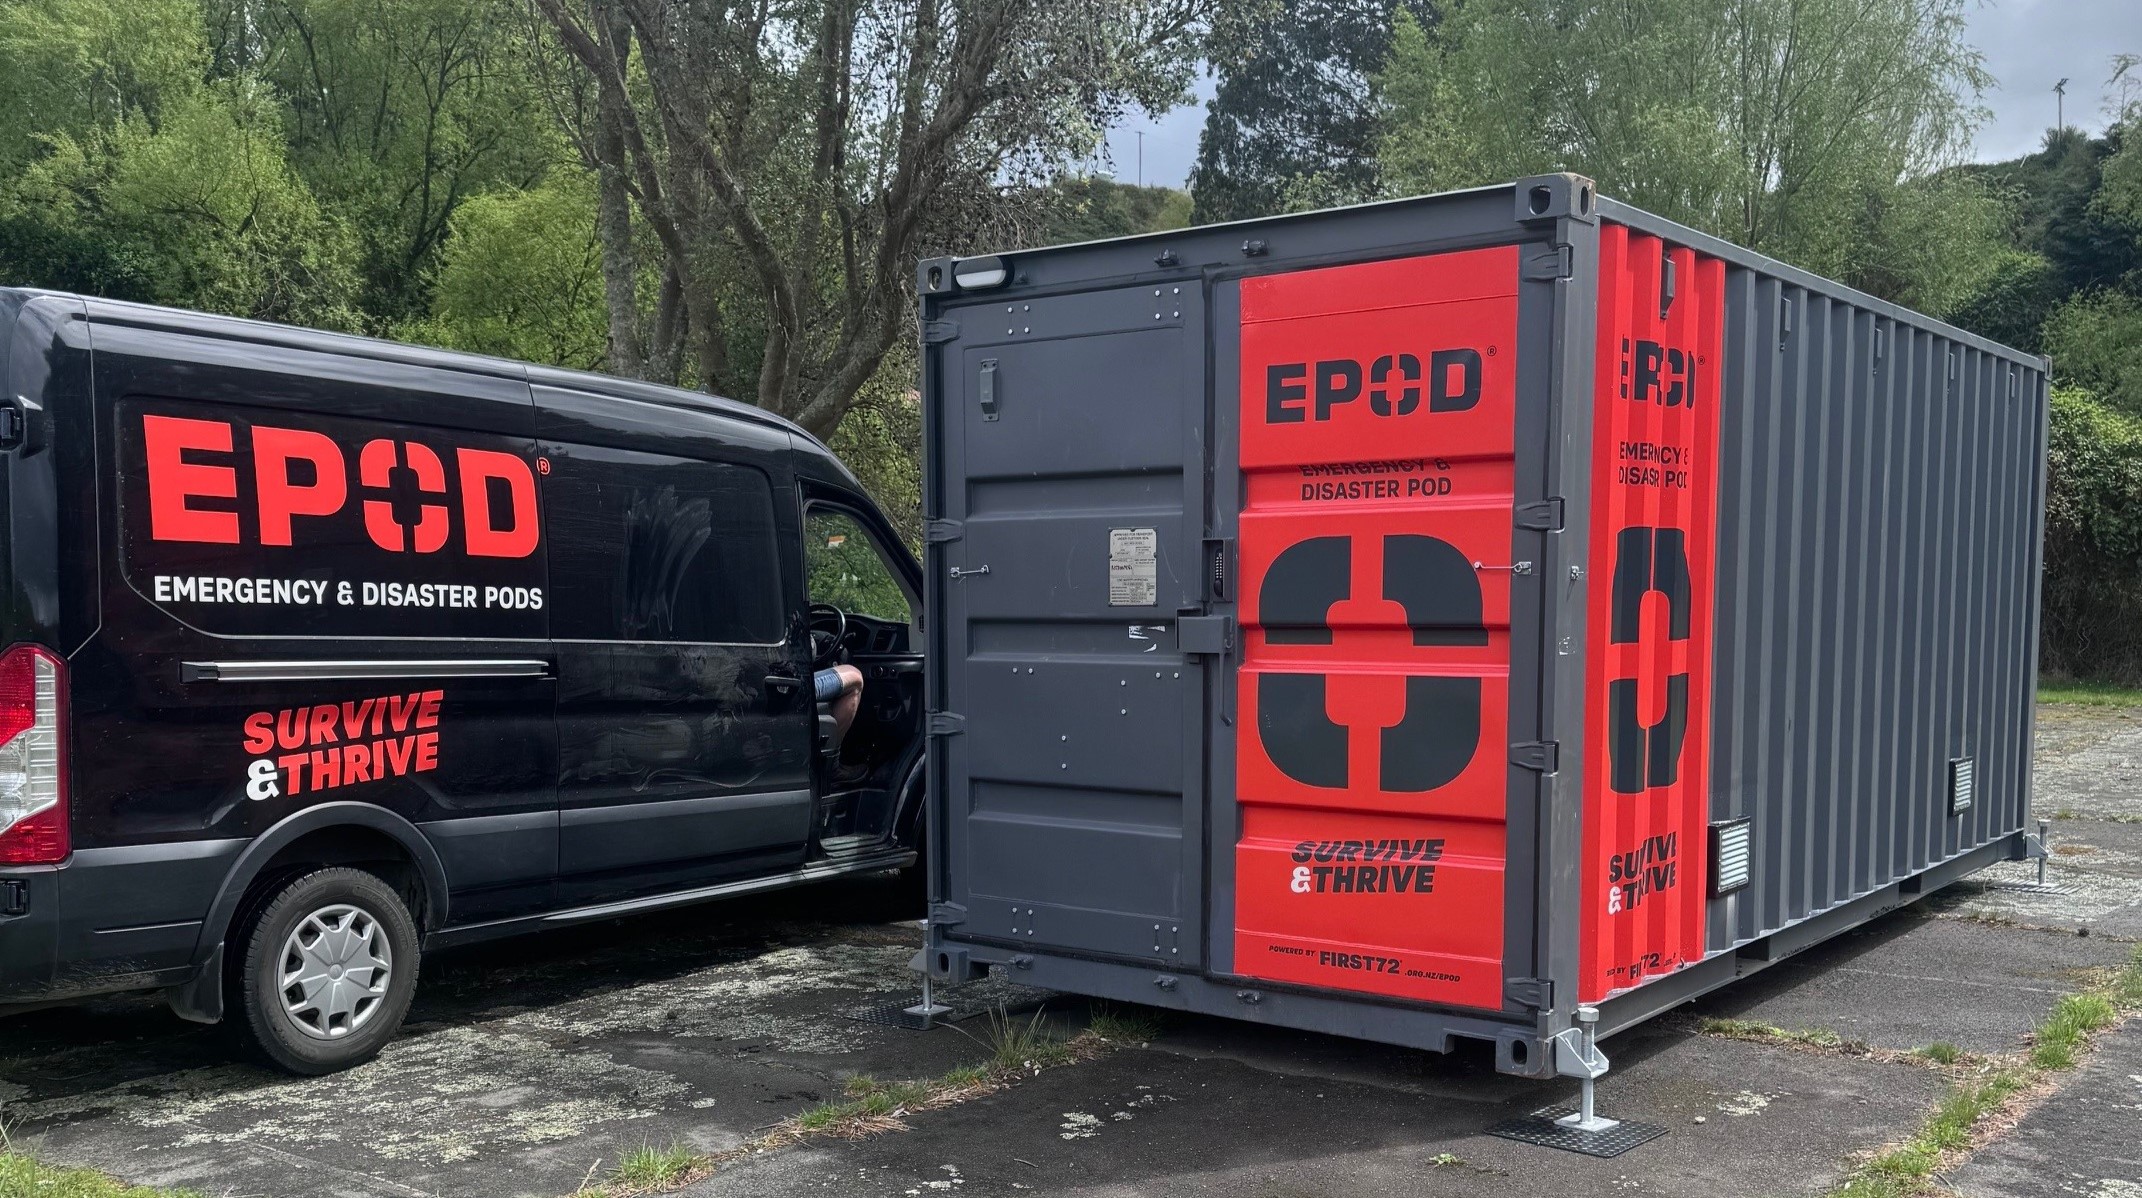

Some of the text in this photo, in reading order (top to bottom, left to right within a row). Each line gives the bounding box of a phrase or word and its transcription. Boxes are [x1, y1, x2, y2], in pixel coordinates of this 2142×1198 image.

[1301, 476, 1452, 501] DISASTER POD
[154, 575, 543, 610] EMERGENCY & DISASTER PODS
[243, 689, 444, 755] SURVIVE
[1291, 838, 1446, 864] SURVIVE
[1268, 945, 1303, 955] POWERED
[1319, 950, 1401, 975] FIRST72
